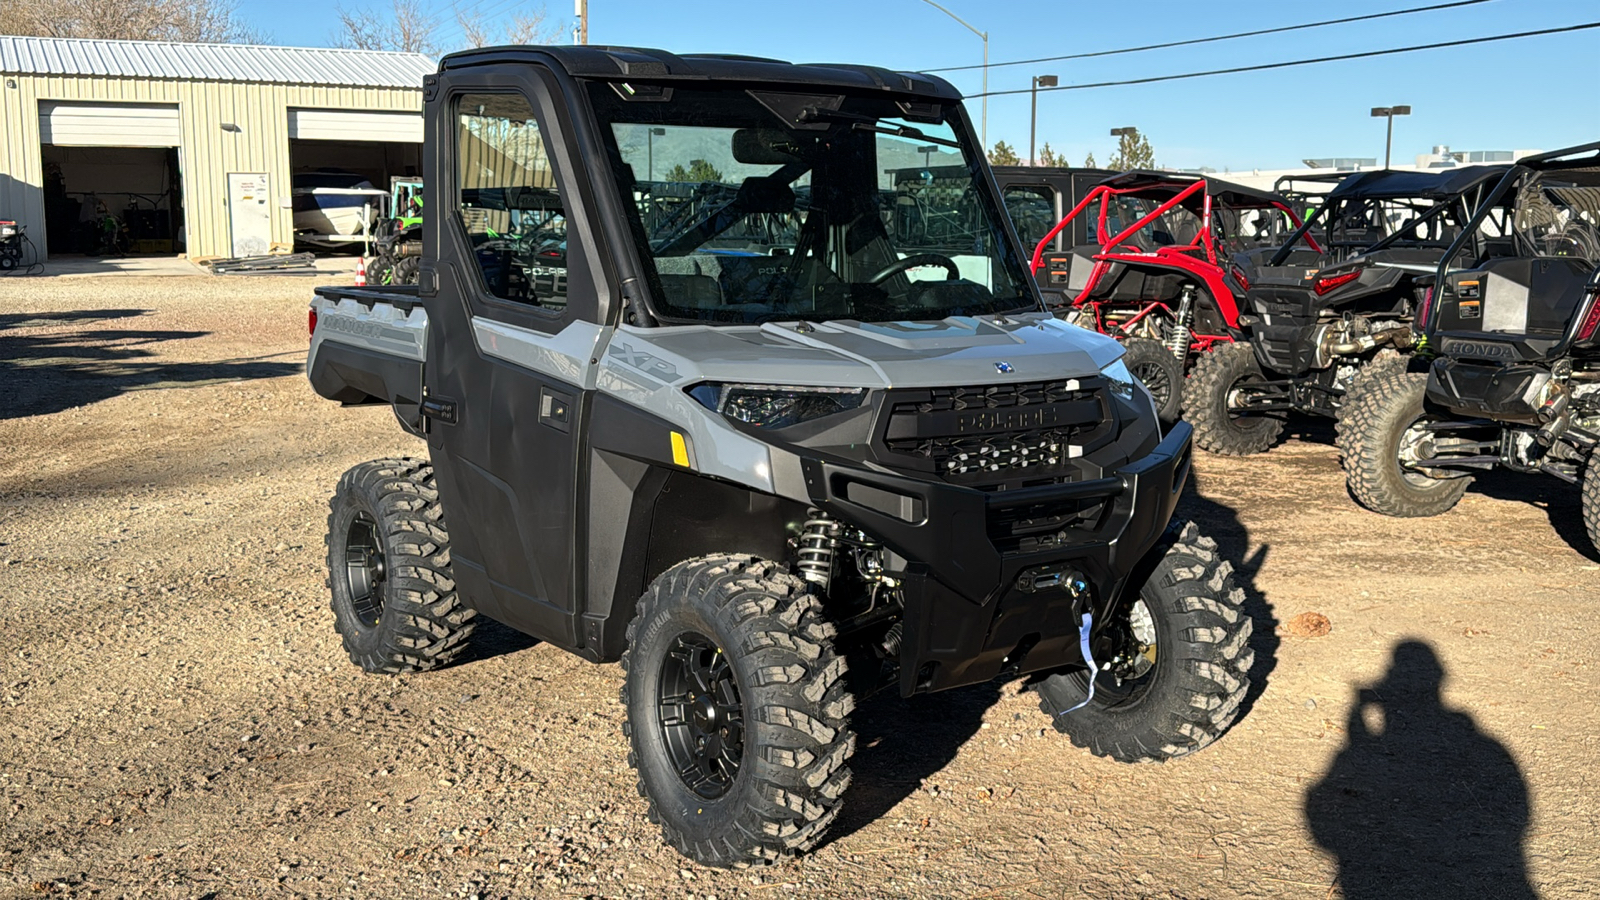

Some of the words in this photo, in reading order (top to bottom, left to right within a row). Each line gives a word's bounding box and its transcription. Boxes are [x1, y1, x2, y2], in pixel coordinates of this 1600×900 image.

[323, 316, 381, 338] RANGER
[608, 342, 677, 375] XP
[1452, 342, 1517, 359] HONDA
[960, 406, 1057, 433] POLARIS
